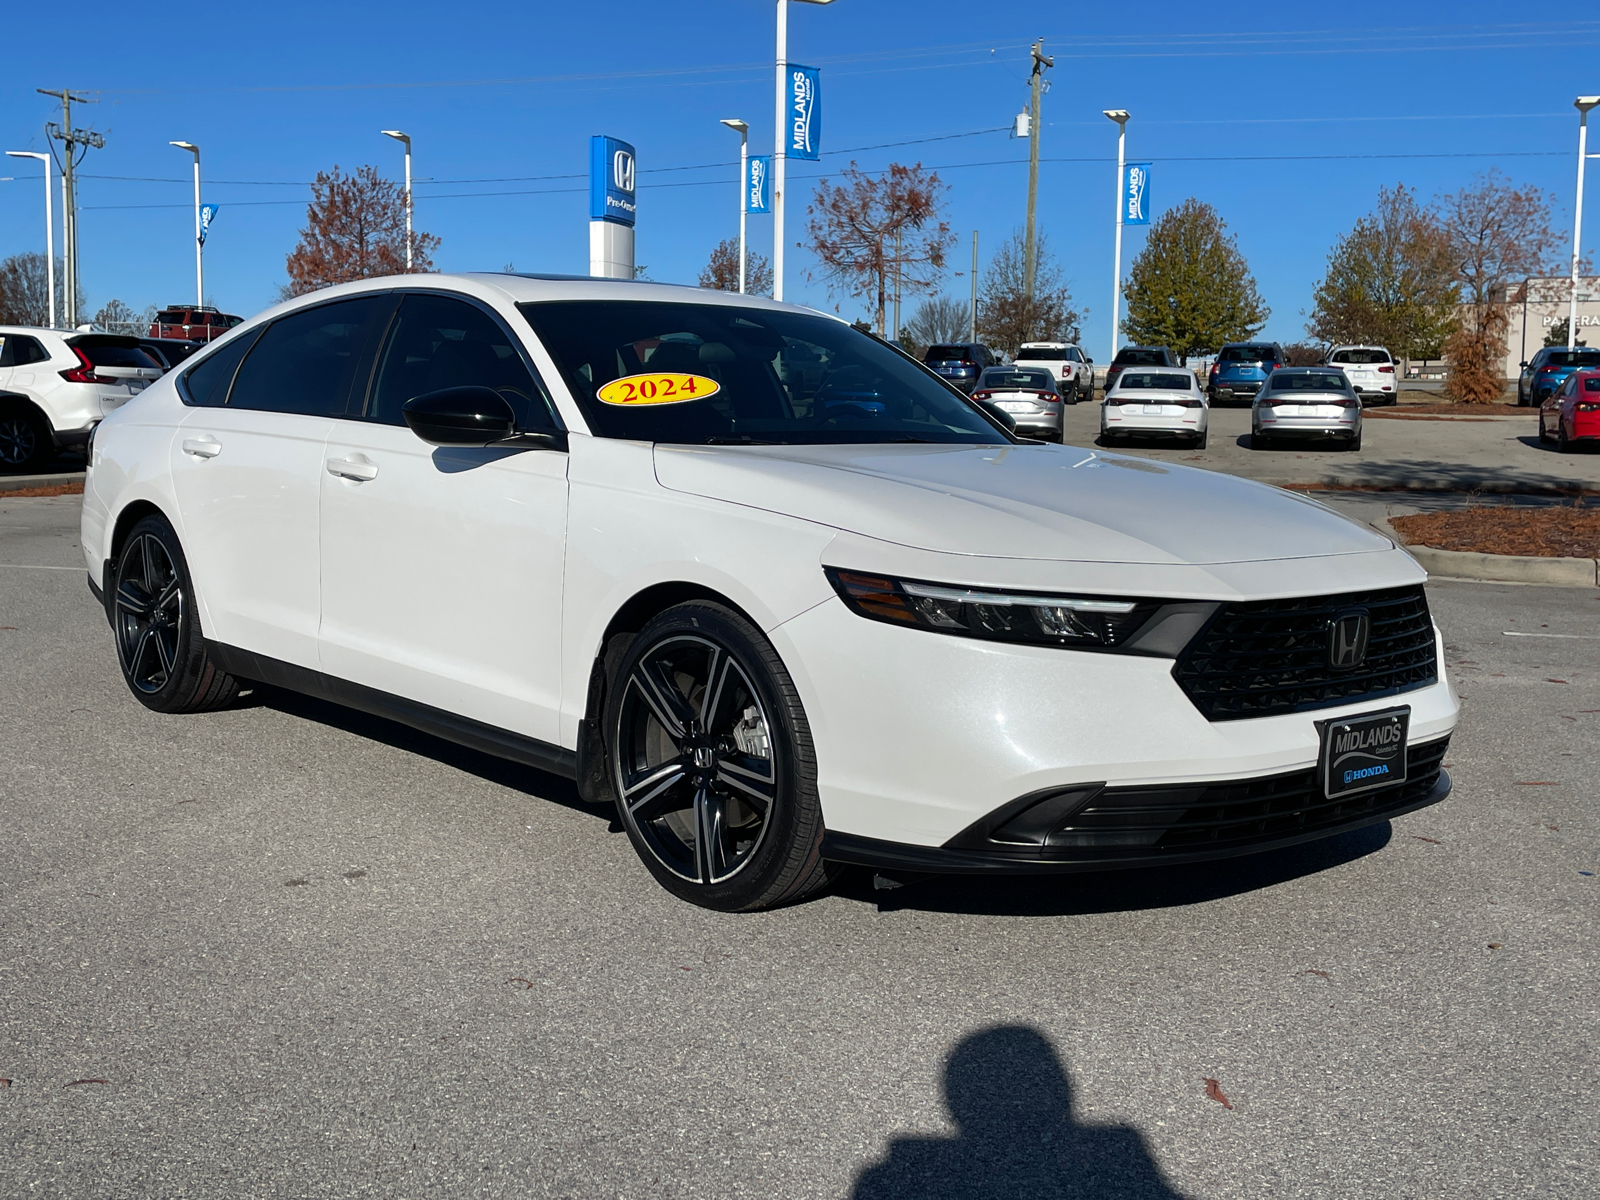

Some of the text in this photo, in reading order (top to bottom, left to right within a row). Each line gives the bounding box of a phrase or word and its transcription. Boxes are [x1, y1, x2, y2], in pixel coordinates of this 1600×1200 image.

[793, 71, 806, 150] MIDLANDS
[751, 159, 760, 208] MIDLANDS
[1129, 167, 1140, 219] MIDLANDS
[619, 377, 698, 403] 2024
[1335, 723, 1402, 754] MIDLANDS
[1353, 764, 1390, 780] HONDA
